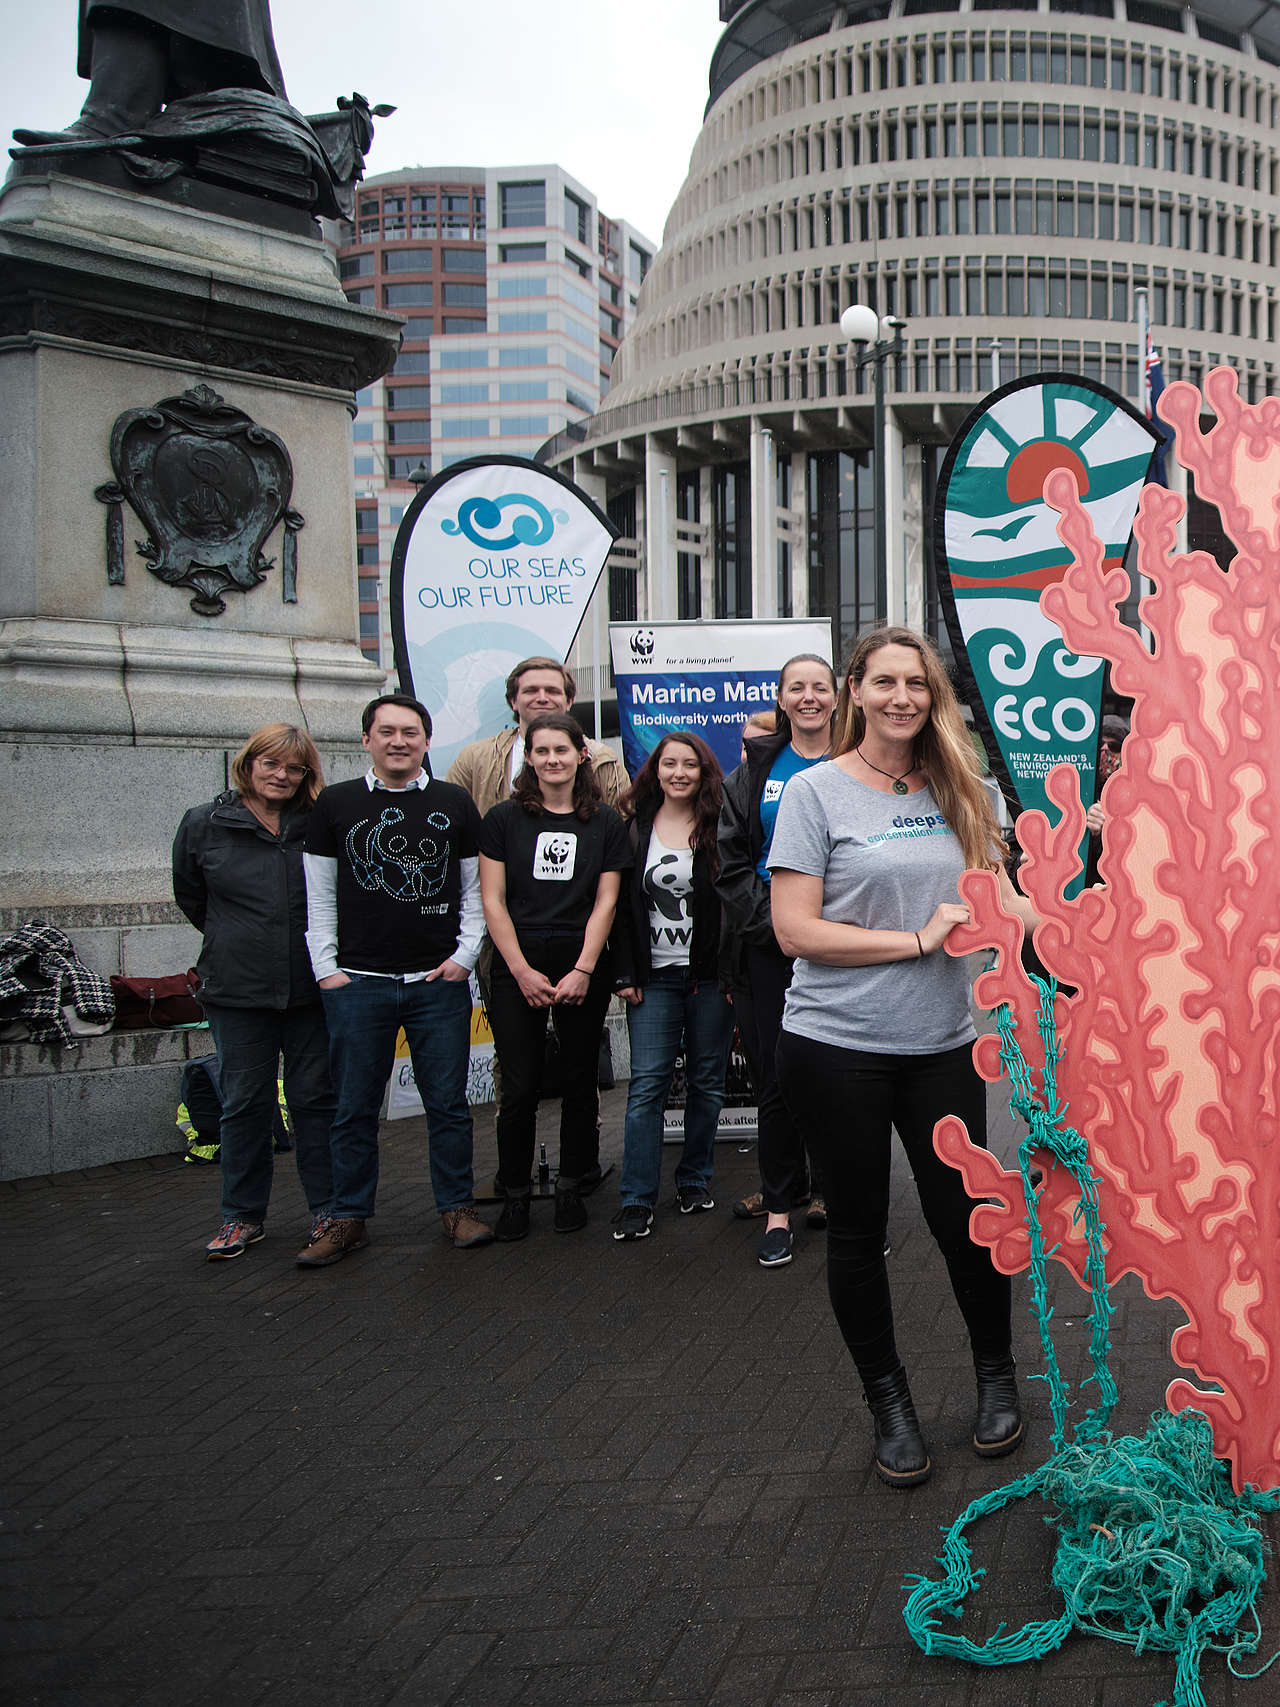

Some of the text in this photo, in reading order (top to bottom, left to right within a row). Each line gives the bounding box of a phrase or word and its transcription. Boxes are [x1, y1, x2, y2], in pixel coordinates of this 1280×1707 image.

[468, 557, 586, 579] OUR SEAS
[418, 584, 574, 609] OUR FUTURE
[666, 656, 677, 665] for
[686, 656, 706, 665] living
[632, 682, 716, 704] Marine
[633, 711, 748, 727] Biodiversity worth
[993, 693, 1096, 742] ECO
[1009, 751, 1088, 763] NEW ZEALAND'S
[1013, 760, 1095, 771] ENVIRONTAL
[541, 865, 566, 874] WWF
